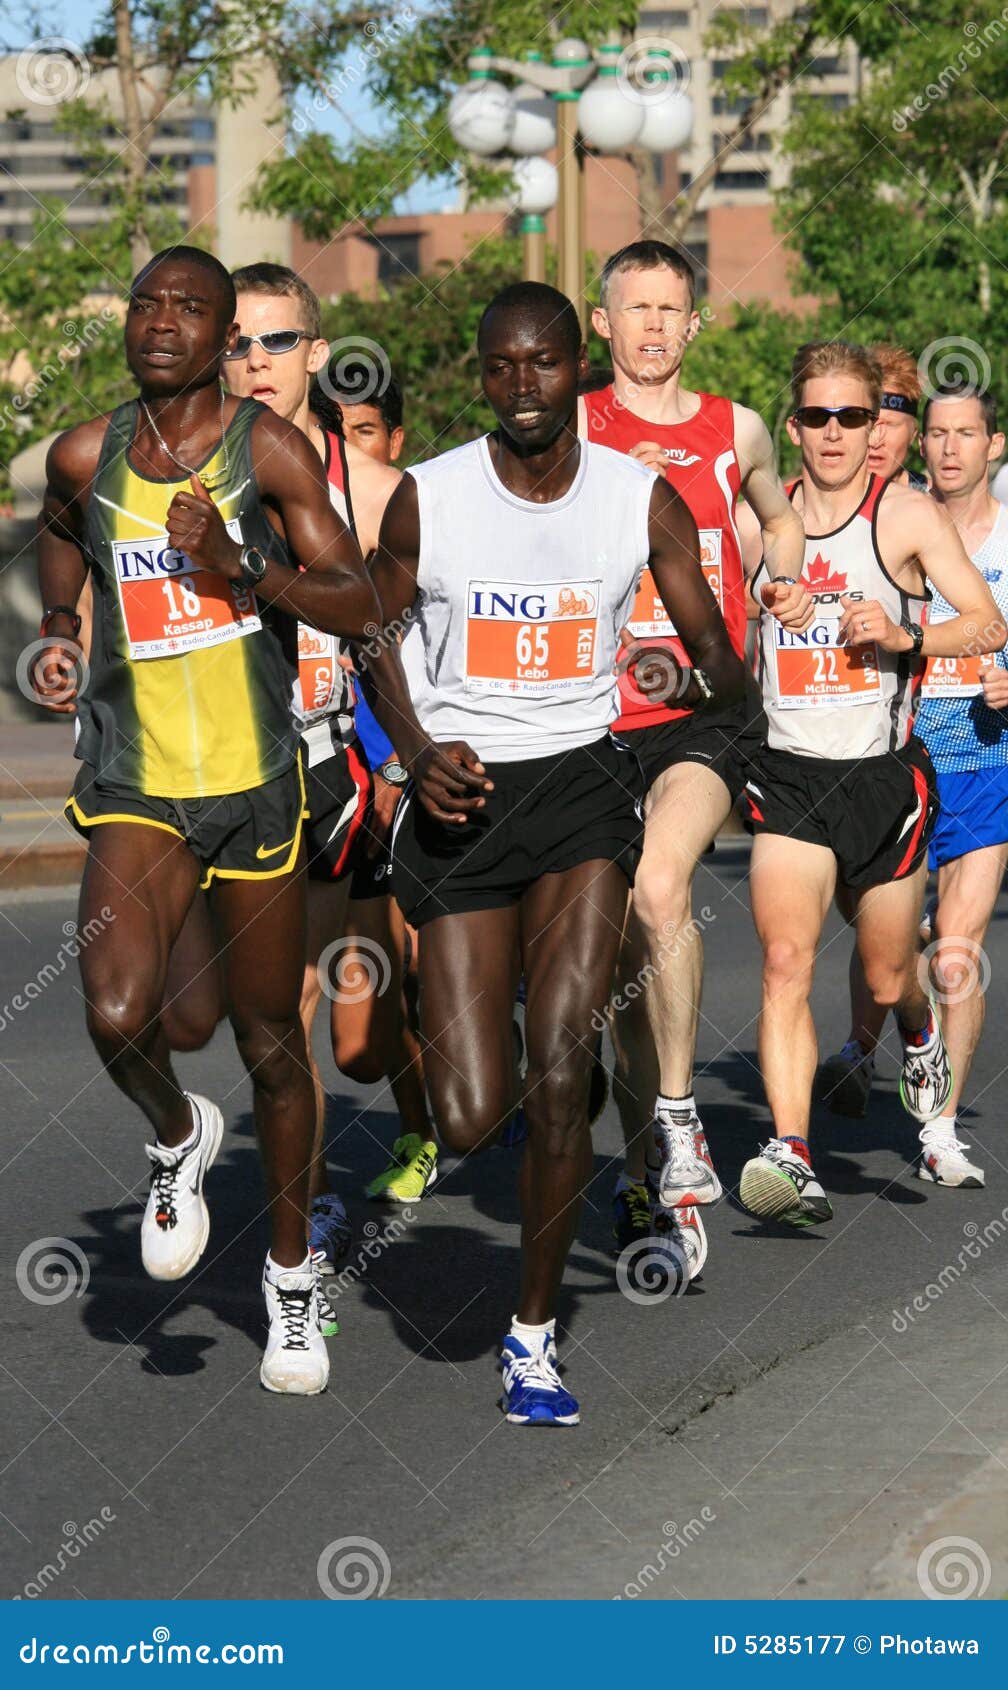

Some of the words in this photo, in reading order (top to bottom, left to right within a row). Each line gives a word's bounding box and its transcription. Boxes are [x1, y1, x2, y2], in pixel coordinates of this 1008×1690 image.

[119, 546, 185, 577] ING
[162, 576, 201, 621] 18
[472, 591, 547, 619] ING
[163, 617, 214, 636] Kassap
[182, 627, 236, 646] Radio-Canada
[778, 625, 830, 646] ING
[516, 625, 549, 666] 65
[576, 628, 594, 668] KEN
[517, 666, 549, 679] Lebo
[812, 650, 839, 682] 22
[862, 651, 878, 684] CAN
[313, 666, 331, 704] CAN
[523, 681, 572, 692] Radio-Canada
[804, 683, 851, 694] McInnes
